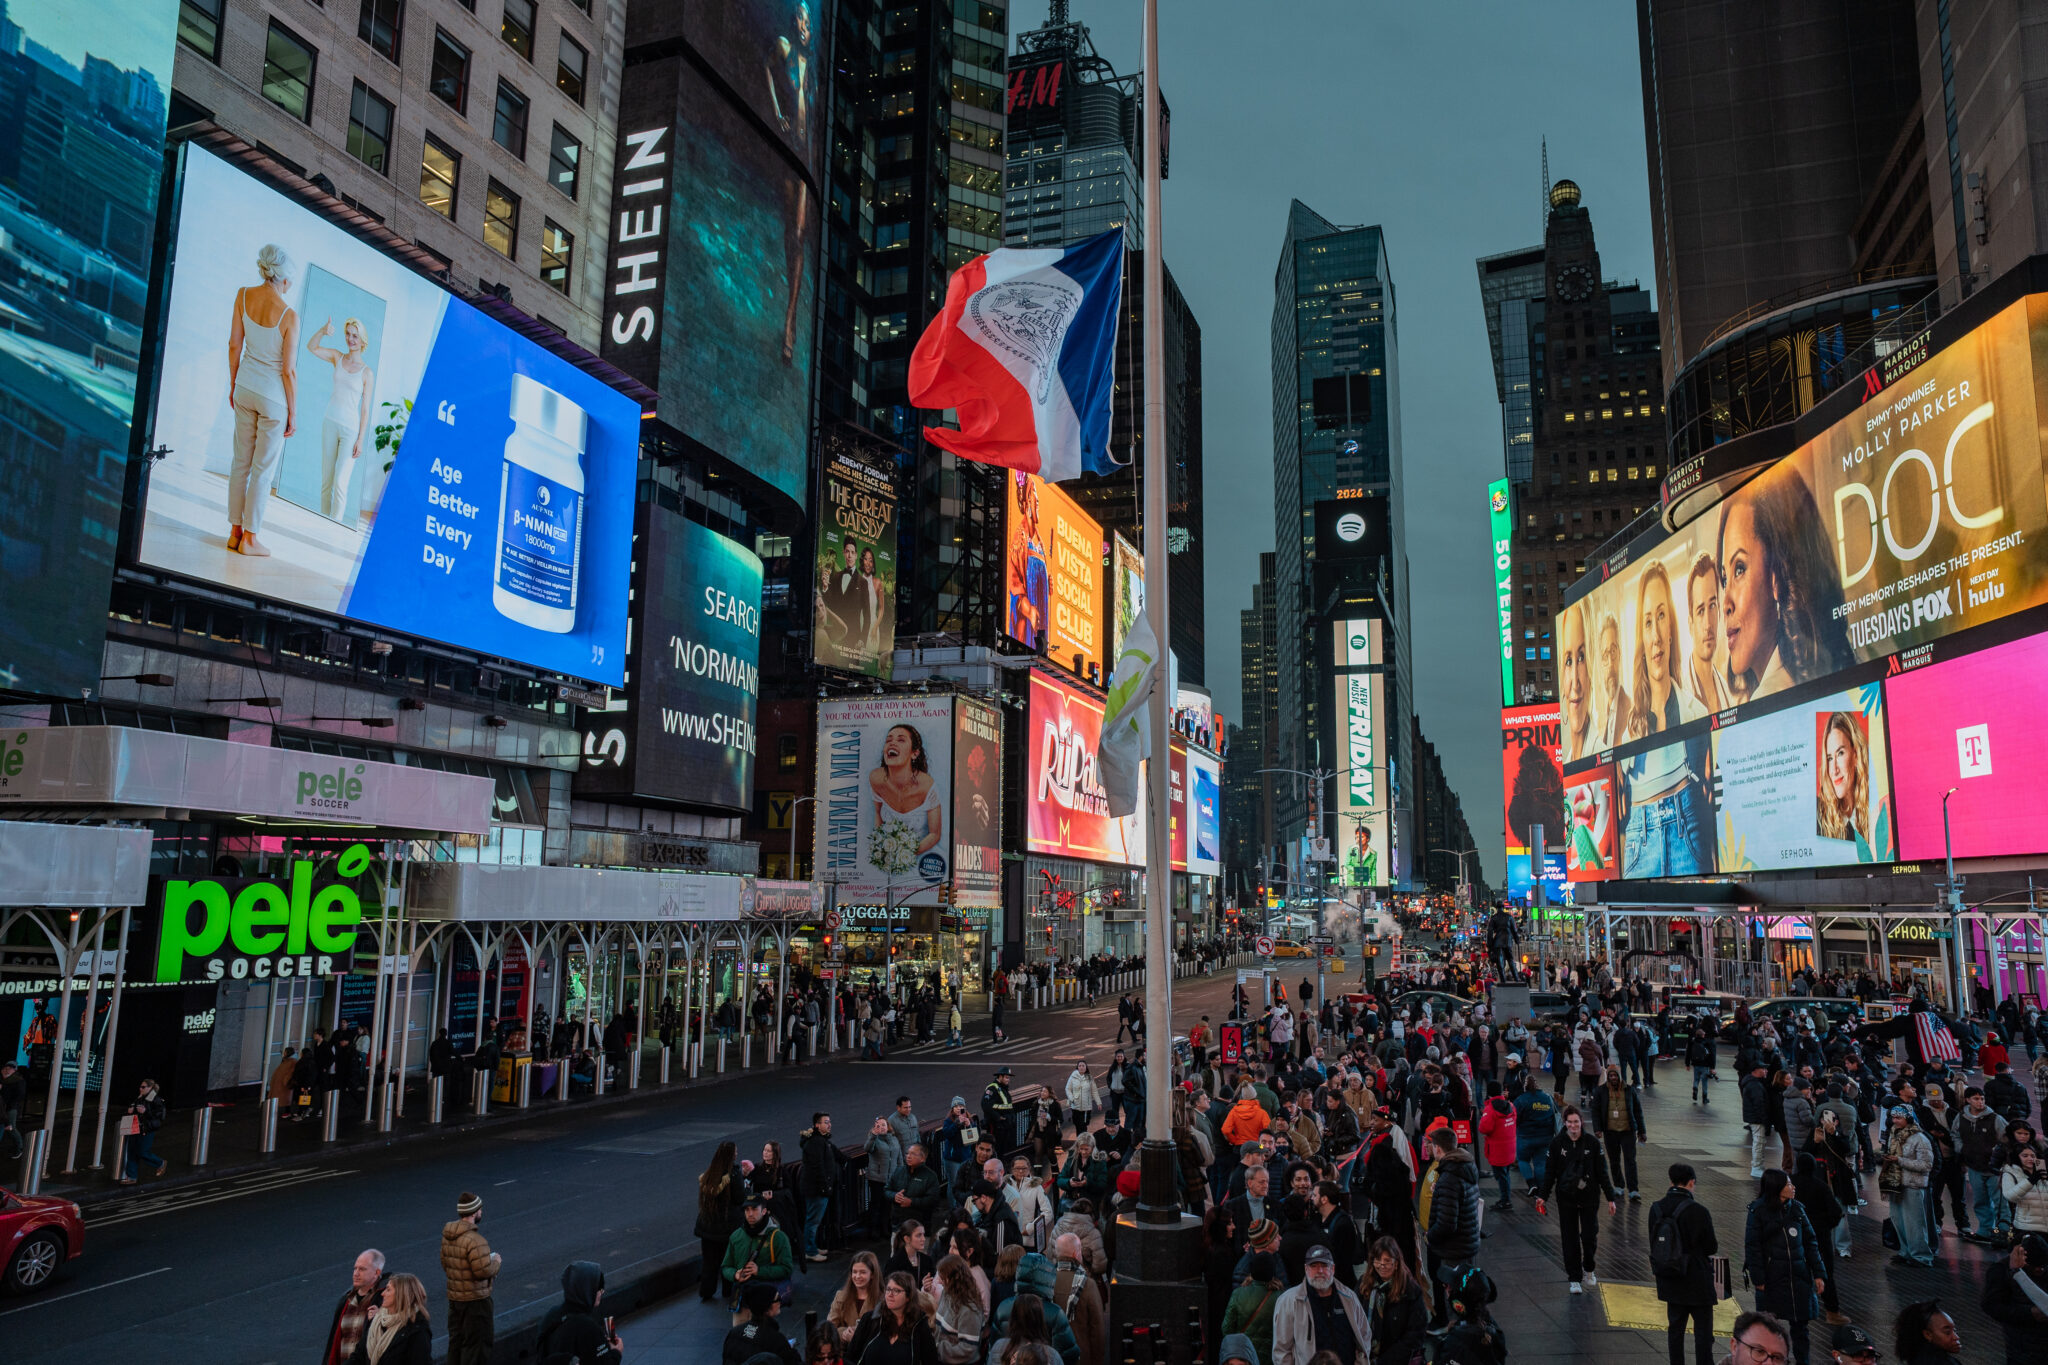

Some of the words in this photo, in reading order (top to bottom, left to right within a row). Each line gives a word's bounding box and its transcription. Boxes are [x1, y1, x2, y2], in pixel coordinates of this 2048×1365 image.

[611, 126, 669, 345] SHEIN
[1884, 330, 1932, 370] MARRIOTT
[1885, 348, 1927, 384] MARQUIS
[1894, 378, 1937, 414] NOMINEE
[1842, 427, 1891, 472] MOLLY
[1900, 380, 1971, 437] PARKER
[430, 457, 463, 486] Age
[831, 461, 851, 475] SINGS
[851, 469, 862, 480] HIS
[863, 474, 879, 487] FACE
[879, 481, 894, 493] OFF!
[864, 466, 889, 482] JORDAN
[1669, 456, 1705, 486] MARRIOTT
[1670, 471, 1701, 497] MARQUIS
[428, 485, 480, 520] Better
[829, 482, 851, 508] THE
[853, 492, 894, 524] GREAT
[1834, 400, 2004, 590] DOC
[425, 514, 473, 551] Every
[835, 506, 886, 540] GATSBY
[1056, 514, 1094, 562] BUENA
[422, 544, 455, 575] Day
[1056, 541, 1093, 591] VISTA
[1495, 539, 1511, 571] 50
[1832, 602, 1857, 620] EVERY
[1858, 583, 1895, 609] MEMORY
[1897, 561, 1947, 593] RESHAPES
[1948, 553, 1969, 572] THE
[1971, 530, 2025, 563] PRESENT.
[1970, 572, 1985, 586] NEXT
[1985, 568, 1999, 581] DAY
[1056, 572, 1094, 617] SOCIAL
[1968, 581, 2005, 608] hulu
[703, 585, 759, 638] SEARCH
[1056, 602, 1093, 647] CLUB
[1497, 575, 1513, 660] YEARS
[1850, 603, 1912, 651] TUESDAYS
[1912, 586, 1953, 628] FOX
[1902, 643, 1934, 660] MARRIOTT
[1903, 655, 1931, 670] MARQUIS
[847, 703, 862, 711] YOU
[865, 702, 900, 710] ALREADY
[902, 701, 927, 709] KNOW
[1350, 678, 1360, 706] MUSIC
[1359, 687, 1368, 707] NEW
[853, 711, 881, 720] GONNA
[883, 710, 902, 718] LOVE
[921, 708, 949, 718] AGAIN!
[1504, 714, 1532, 725] WHAT'S
[830, 730, 861, 779] MIA!
[1349, 707, 1375, 806] FRIDAY
[296, 763, 365, 805] pelé
[310, 798, 349, 809] SOCCER
[1073, 791, 1094, 813] DRAG
[827, 784, 859, 869] MAMMA
[643, 842, 709, 865] EXPRESS
[1780, 847, 1813, 859] SEPHORA
[1891, 865, 1921, 875] SEPHORA
[156, 843, 370, 983] pelé
[755, 890, 778, 911] GIFTS
[781, 890, 811, 912] LUGGAGE
[837, 907, 910, 919] LUGGAGE
[207, 956, 333, 980] SOCCER
[637, 960, 661, 970] GFTS
[183, 1007, 216, 1029] pelé
